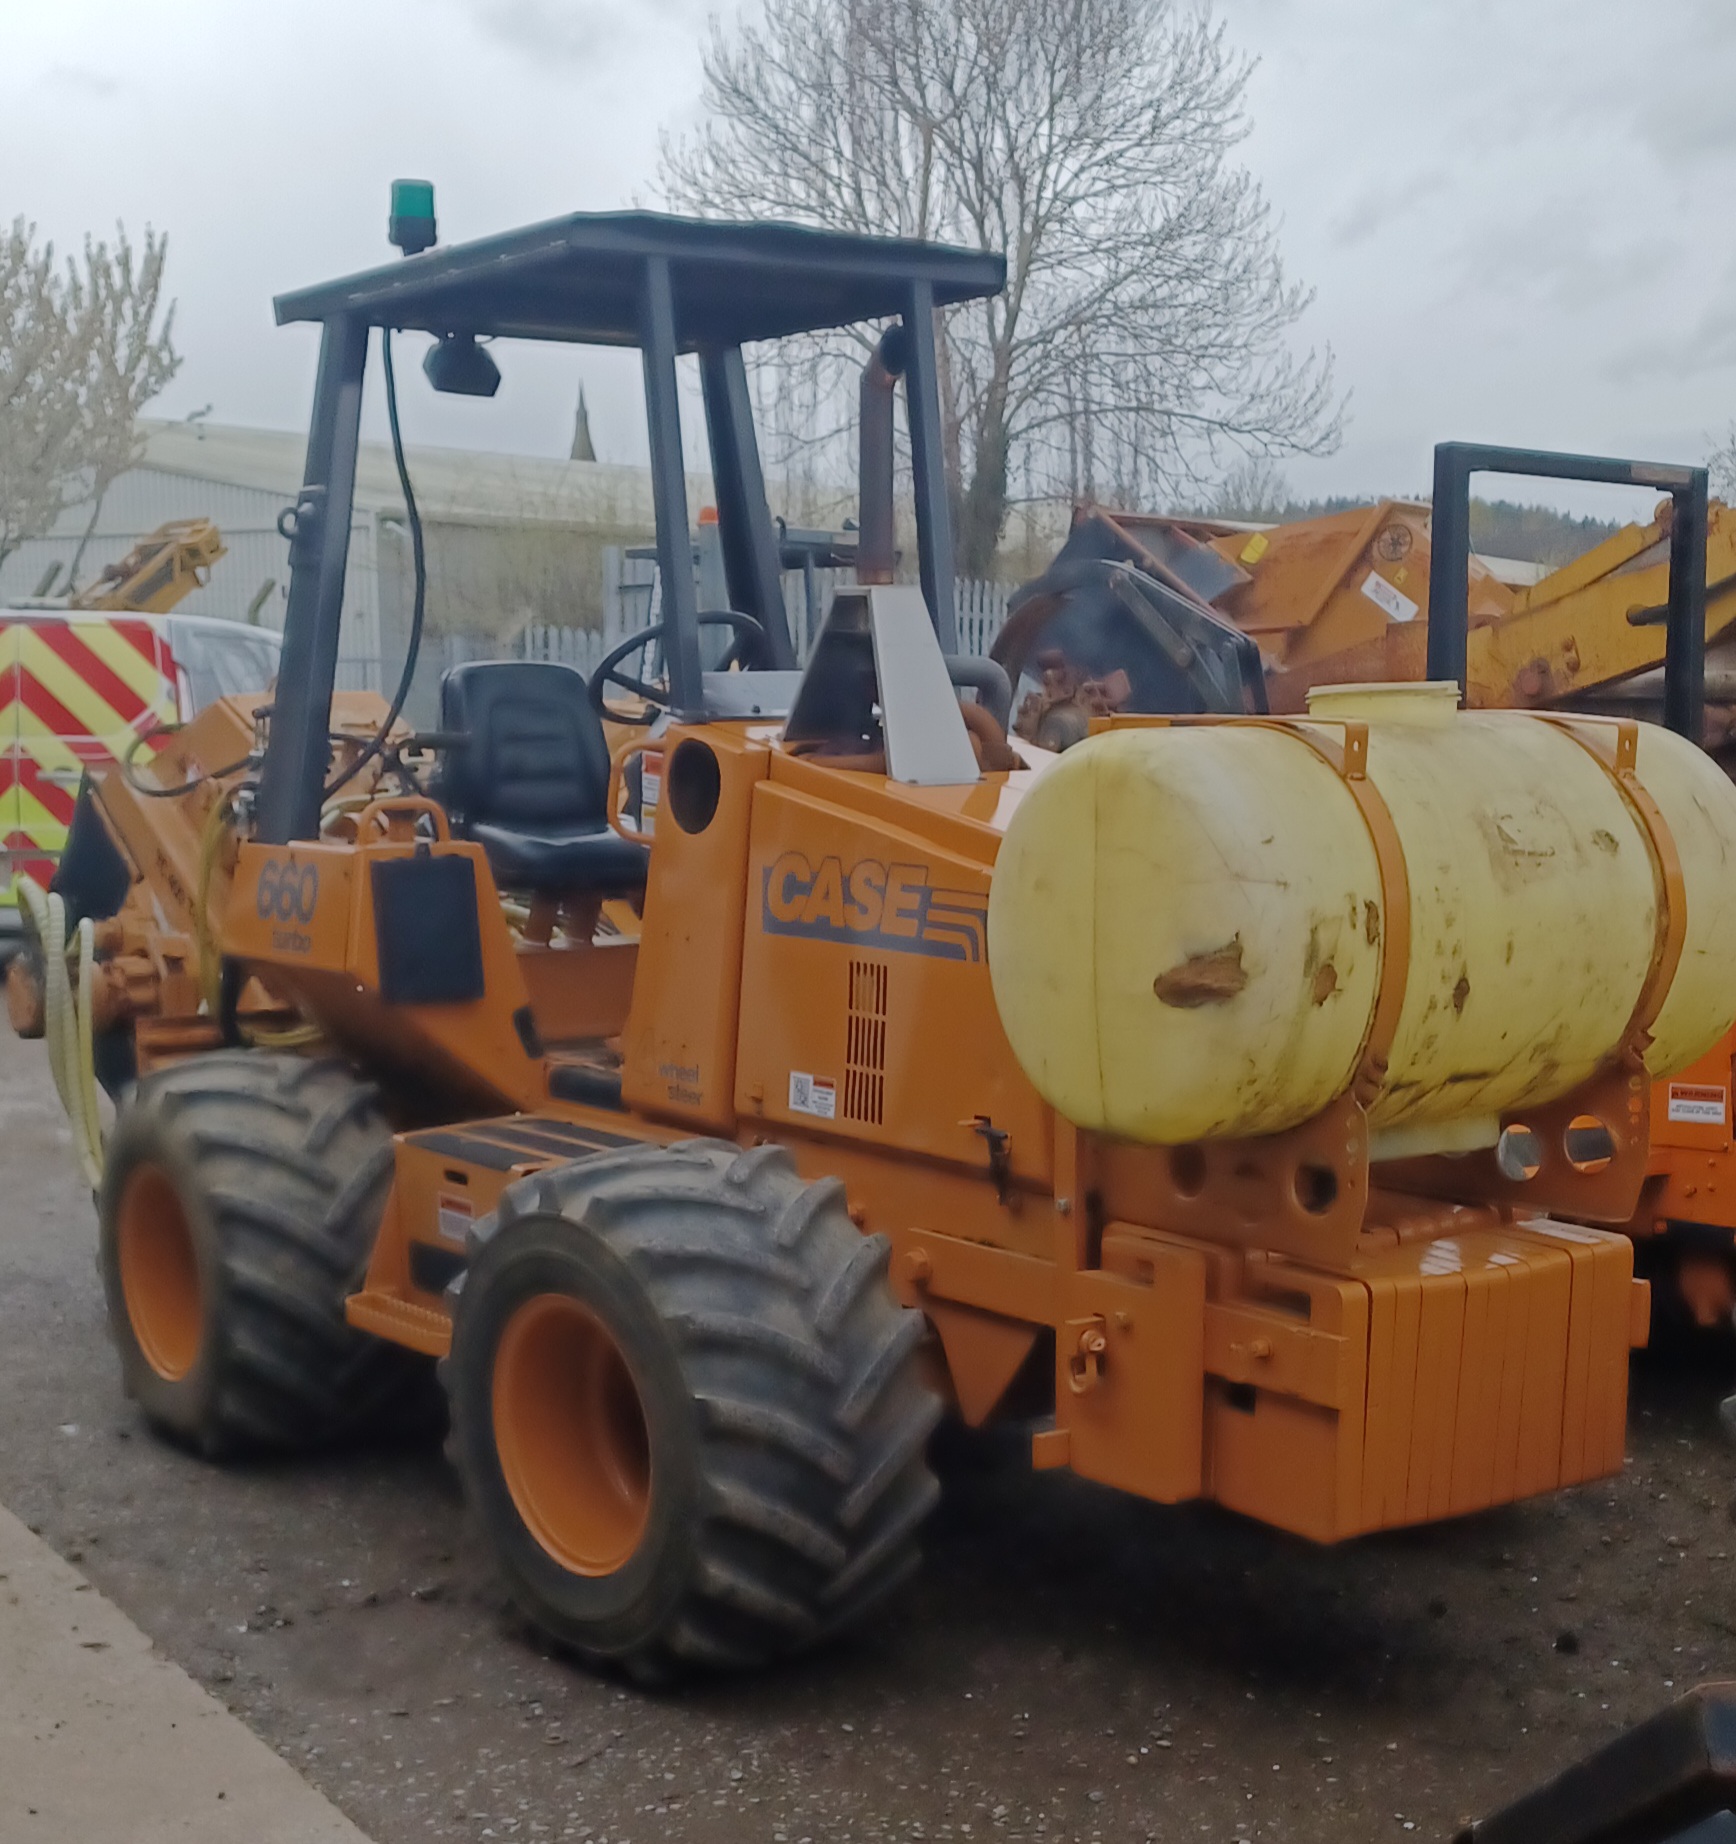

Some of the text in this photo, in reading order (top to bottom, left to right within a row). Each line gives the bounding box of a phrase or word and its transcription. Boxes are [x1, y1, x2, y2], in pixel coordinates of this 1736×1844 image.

[257, 859, 320, 925] 660
[767, 851, 928, 938] CASE
[658, 1063, 700, 1084] wheel
[667, 1084, 704, 1106] steer
